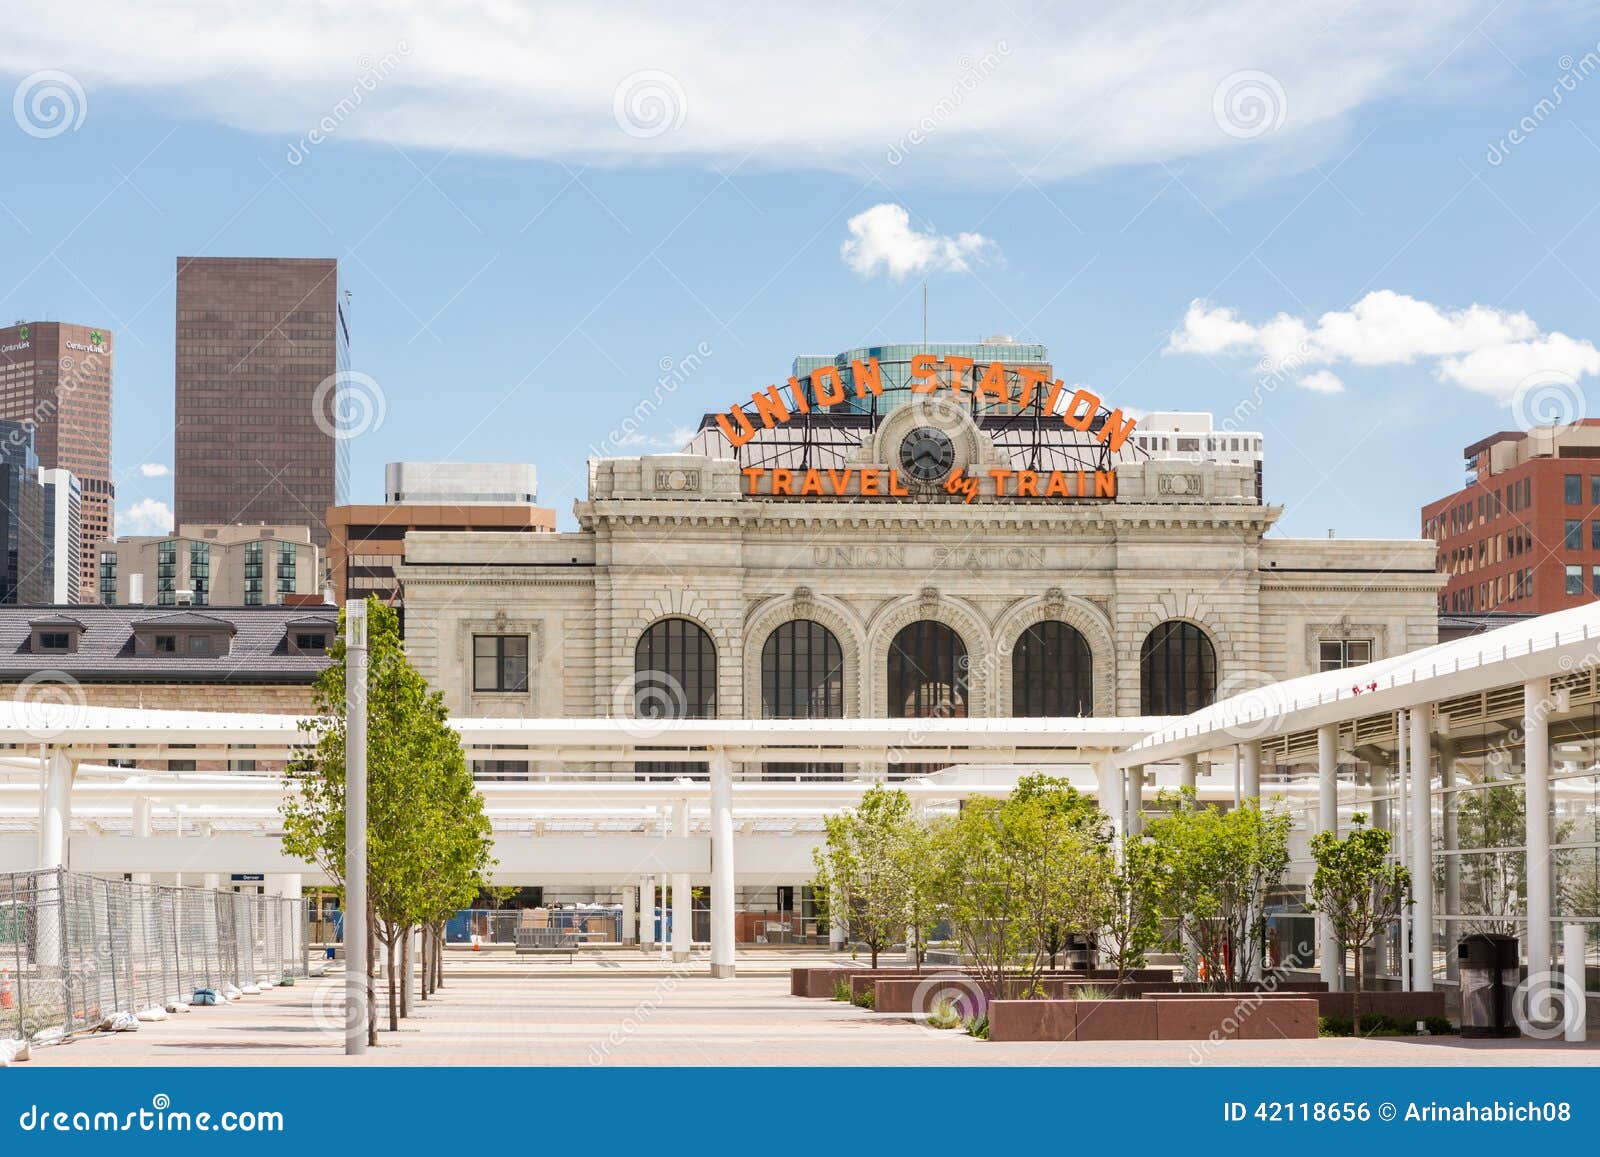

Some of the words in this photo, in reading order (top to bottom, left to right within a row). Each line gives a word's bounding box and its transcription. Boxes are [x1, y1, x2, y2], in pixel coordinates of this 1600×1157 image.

[715, 356, 883, 448] UNION
[910, 354, 1137, 453] STATION
[742, 468, 908, 496] TRAVEL
[944, 467, 980, 504] by
[989, 469, 1118, 497] TRAIN
[813, 547, 906, 568] UNION
[931, 547, 1047, 569] STATION
